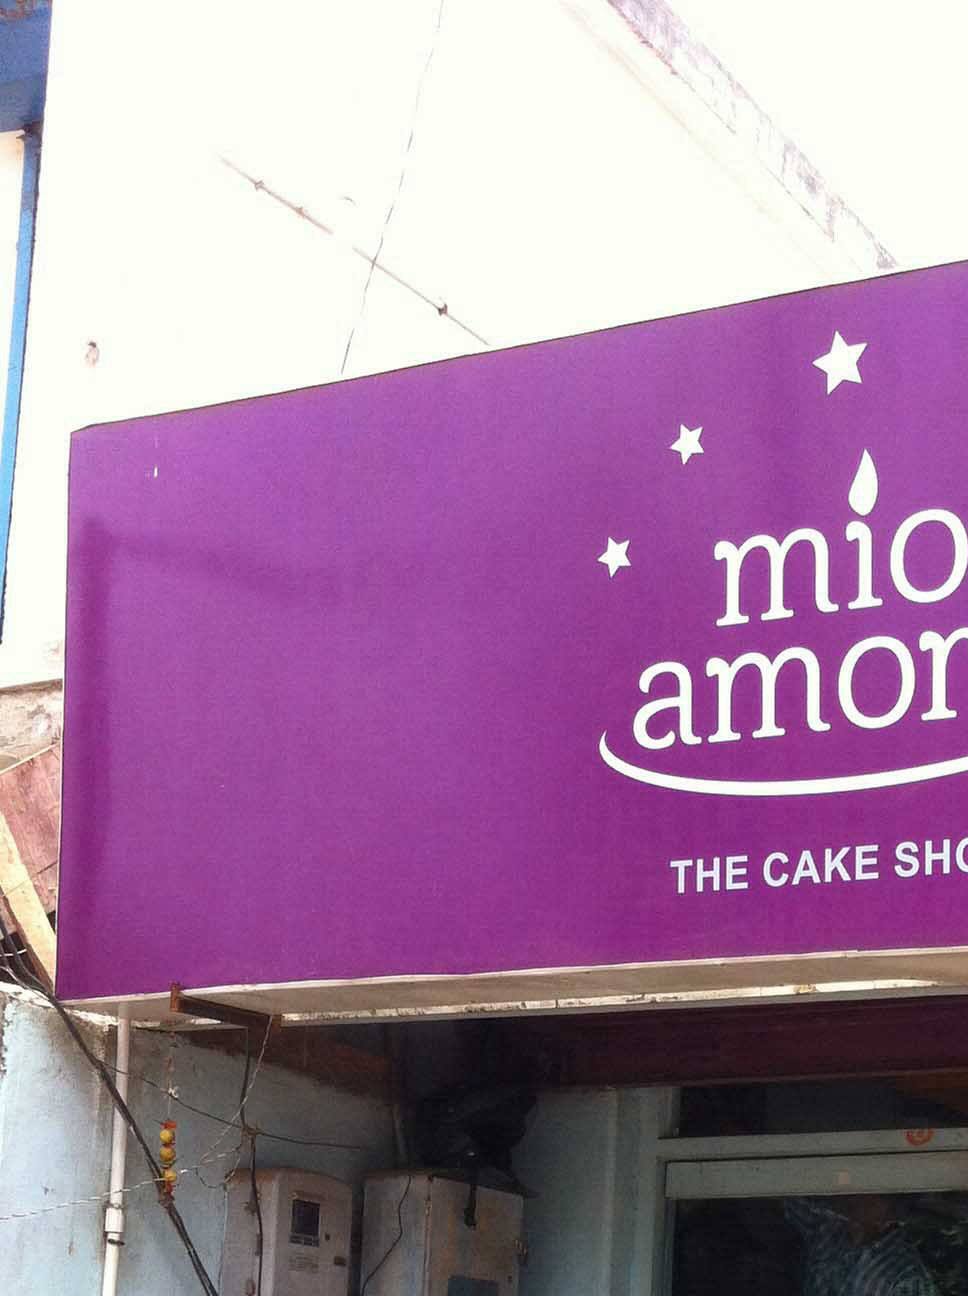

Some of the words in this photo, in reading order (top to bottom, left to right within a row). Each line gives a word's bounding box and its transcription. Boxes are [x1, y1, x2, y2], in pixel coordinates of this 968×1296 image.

[713, 507, 968, 627] mio
[669, 855, 749, 895] THE
[763, 844, 880, 888] CAKE
